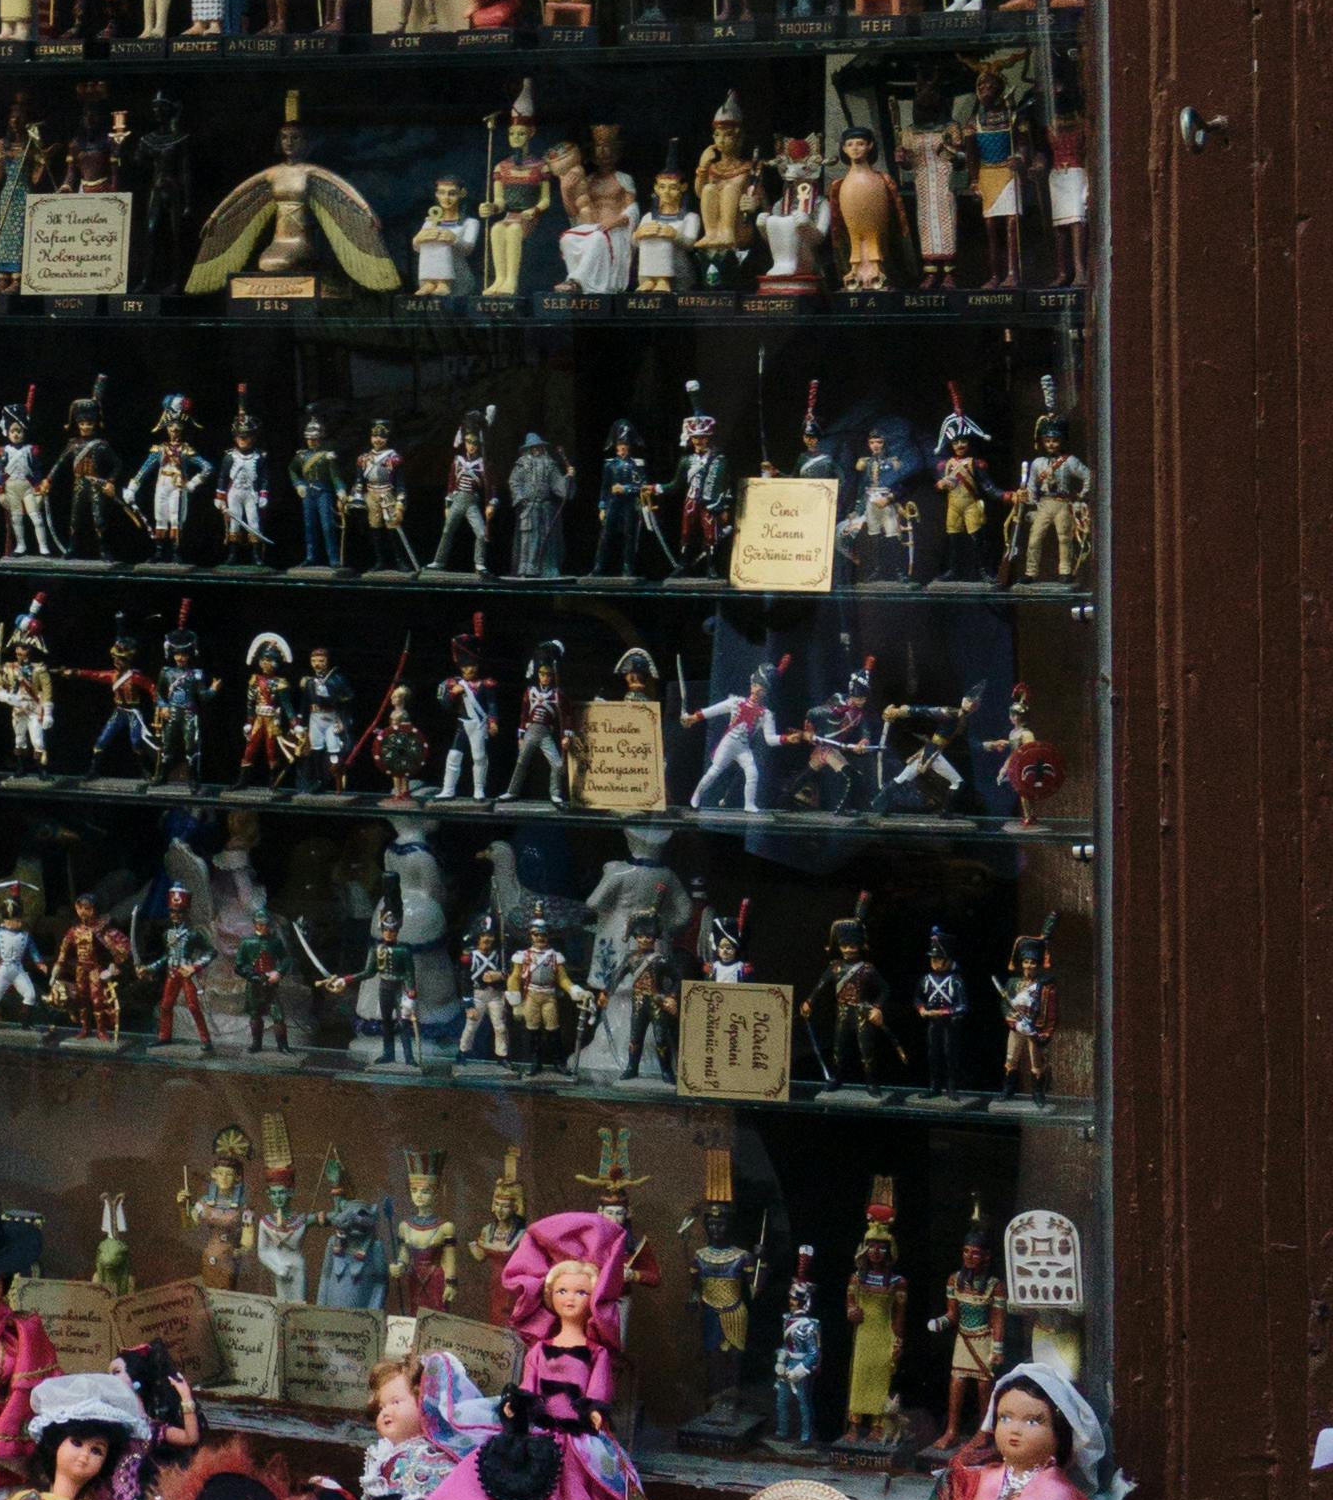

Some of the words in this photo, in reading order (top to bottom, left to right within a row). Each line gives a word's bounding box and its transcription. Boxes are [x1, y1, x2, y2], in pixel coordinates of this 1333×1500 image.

[713, 26, 736, 38] RA
[861, 21, 893, 32] HEH
[390, 37, 421, 47] ATON
[64, 210, 108, 225] Üretilen
[34, 229, 75, 248] Safran
[79, 229, 118, 247] Çiçeği
[37, 249, 113, 267] Kolonyasını
[255, 299, 289, 311] ISIS
[542, 297, 602, 311] SERAPIS
[1039, 294, 1077, 307] SETH
[770, 500, 799, 517] Cinci
[742, 544, 792, 565] Gördünüz
[616, 739, 652, 760] Çiçeği
